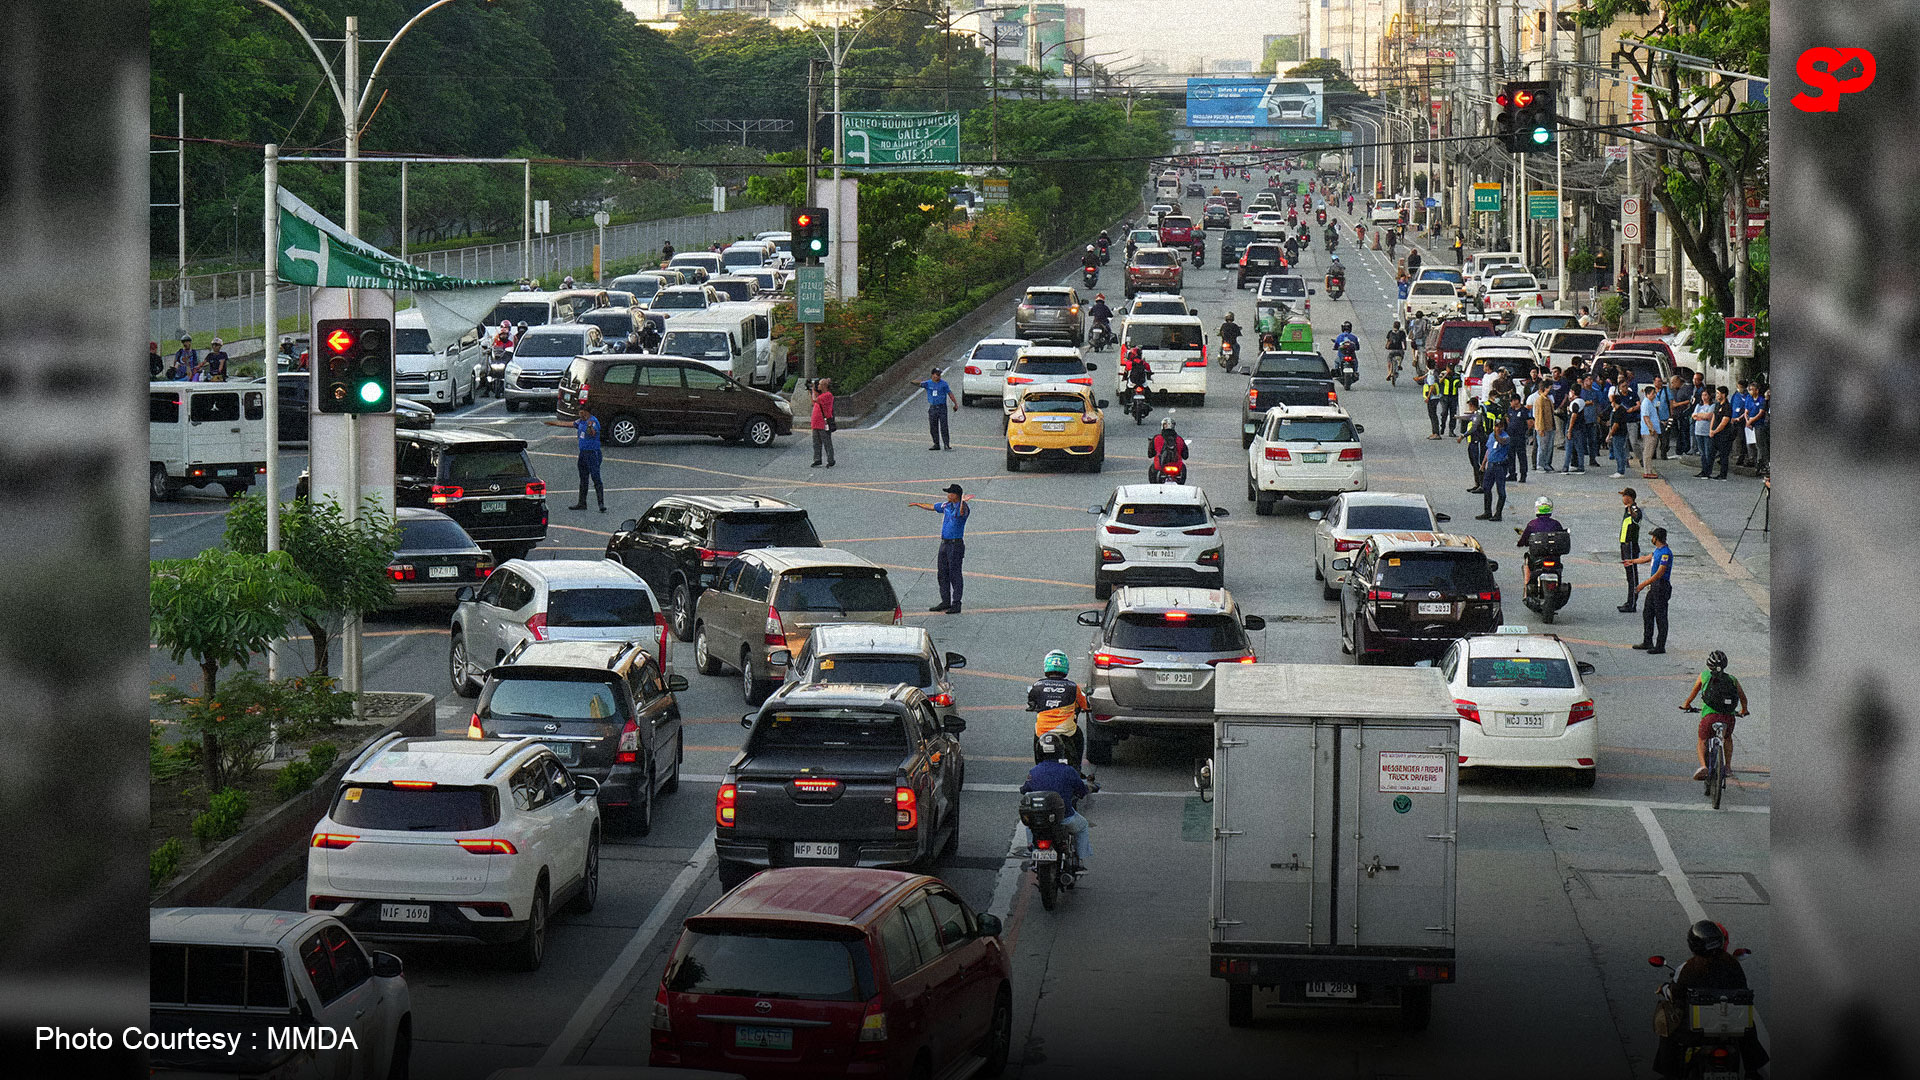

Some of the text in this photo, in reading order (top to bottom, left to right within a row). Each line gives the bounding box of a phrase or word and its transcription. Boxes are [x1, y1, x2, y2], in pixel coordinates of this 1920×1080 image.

[897, 129, 920, 140] GATE
[894, 149, 918, 161] GATE
[346, 275, 380, 288] WITH
[1506, 717, 1520, 726] NCJ
[1389, 773, 1409, 781] TRUCK
[795, 845, 838, 856] NFP 5609
[382, 907, 428, 919] NIF 1696
